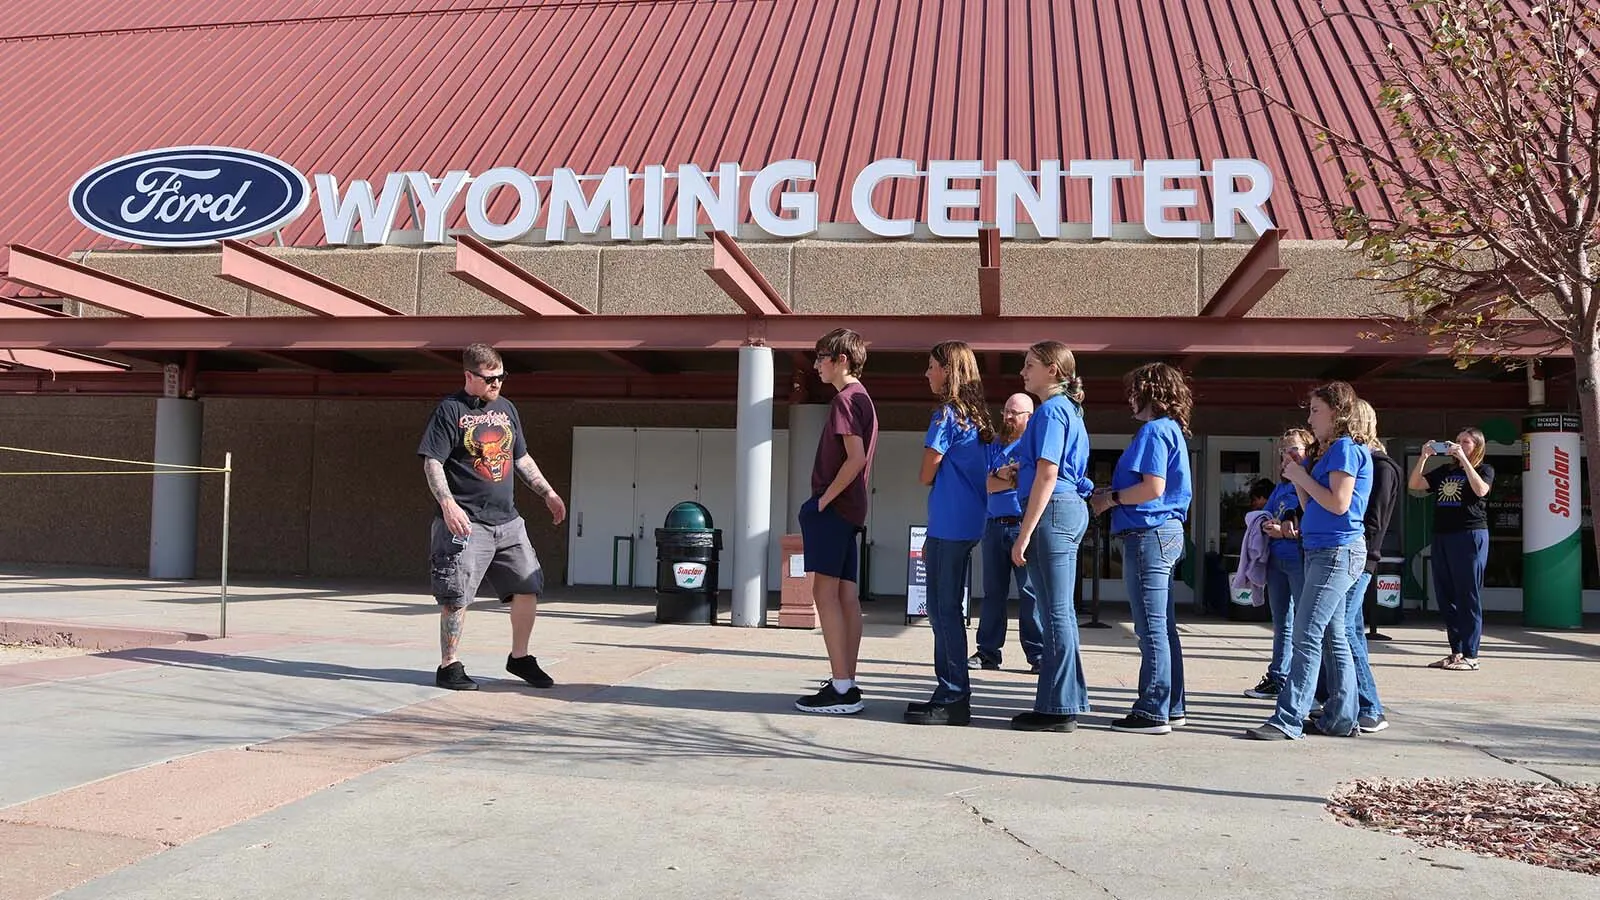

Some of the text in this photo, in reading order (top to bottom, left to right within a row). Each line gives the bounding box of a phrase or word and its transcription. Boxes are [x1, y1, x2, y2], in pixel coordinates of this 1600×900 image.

[120, 168, 252, 224] Ford
[315, 158, 1275, 246] WYOMING CENTER
[1548, 445, 1570, 518] Sinclair
[677, 566, 703, 575] Sinclair
